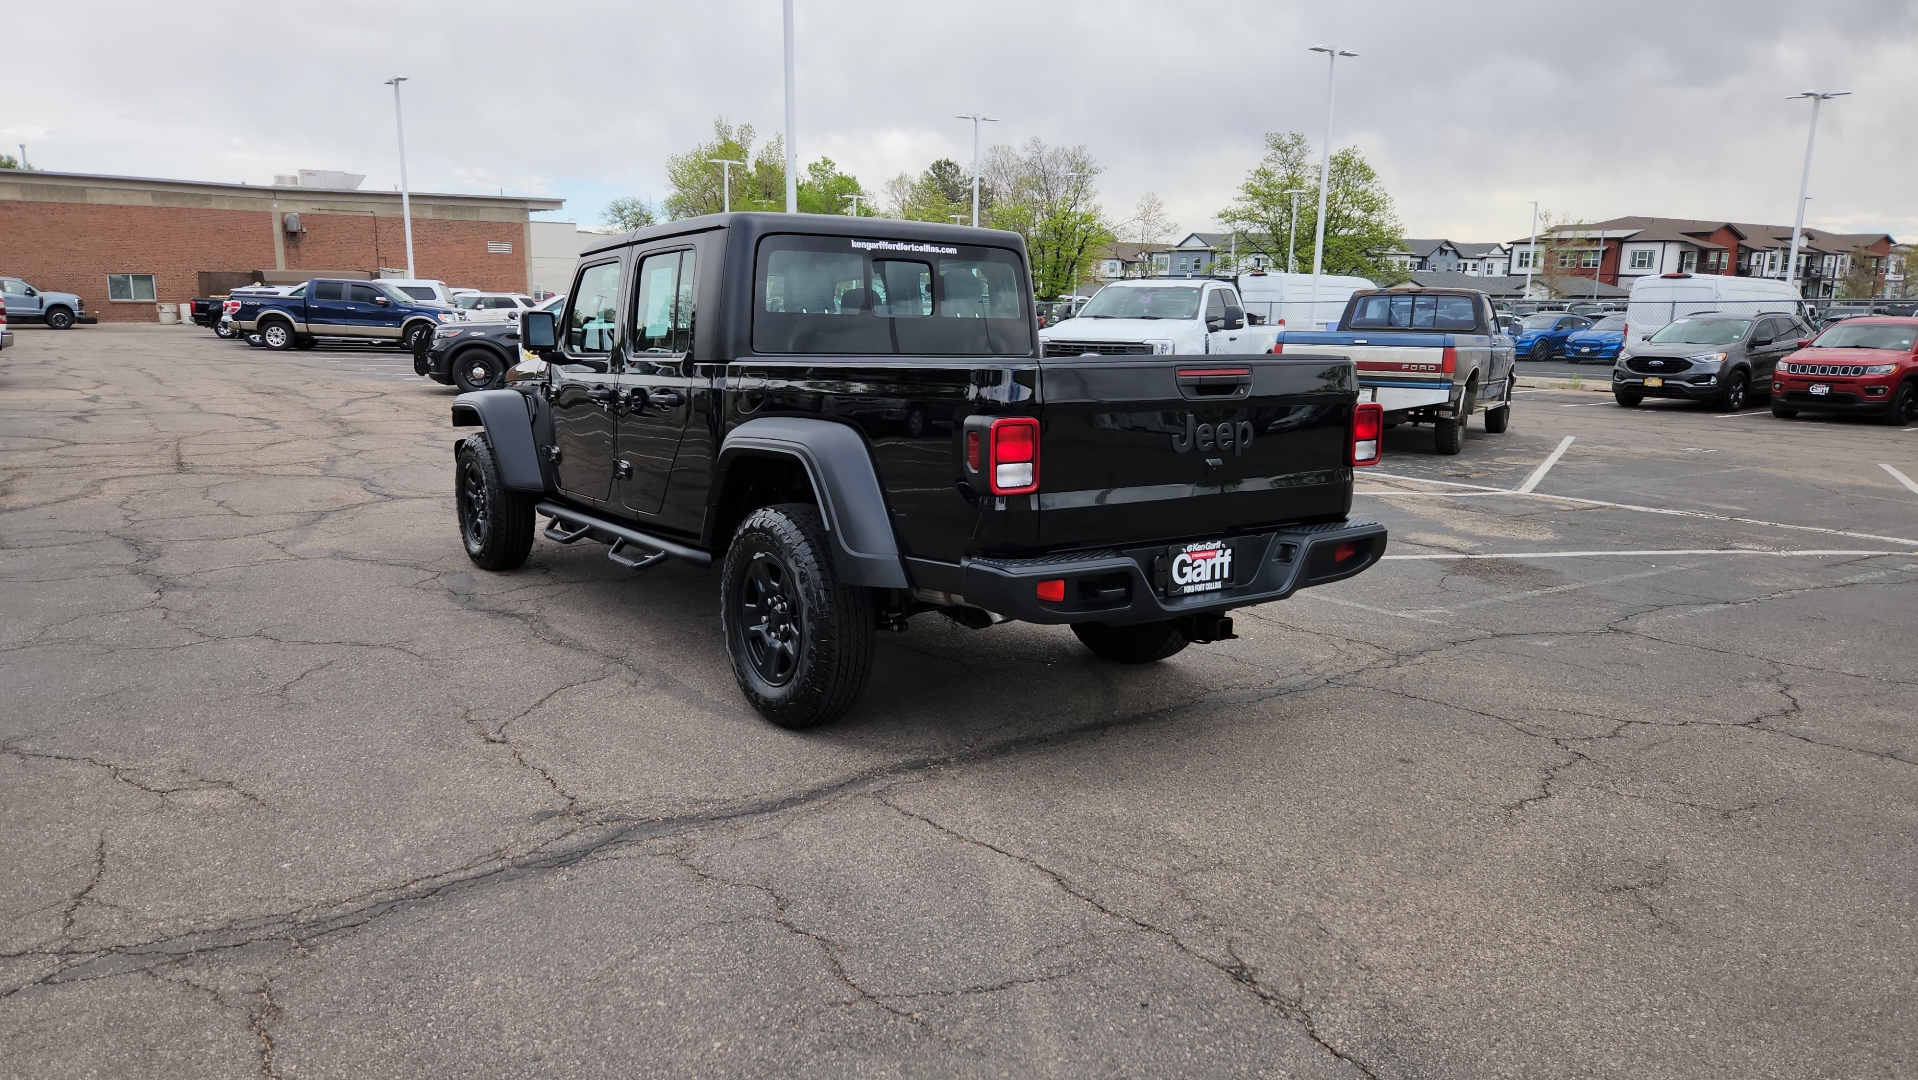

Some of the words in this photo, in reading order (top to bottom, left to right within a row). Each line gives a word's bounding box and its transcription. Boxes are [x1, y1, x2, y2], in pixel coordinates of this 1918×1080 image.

[851, 239, 957, 254] kengarfffordfortcollins.com
[1171, 414, 1254, 457] Jeep
[1172, 549, 1232, 585] Garff
